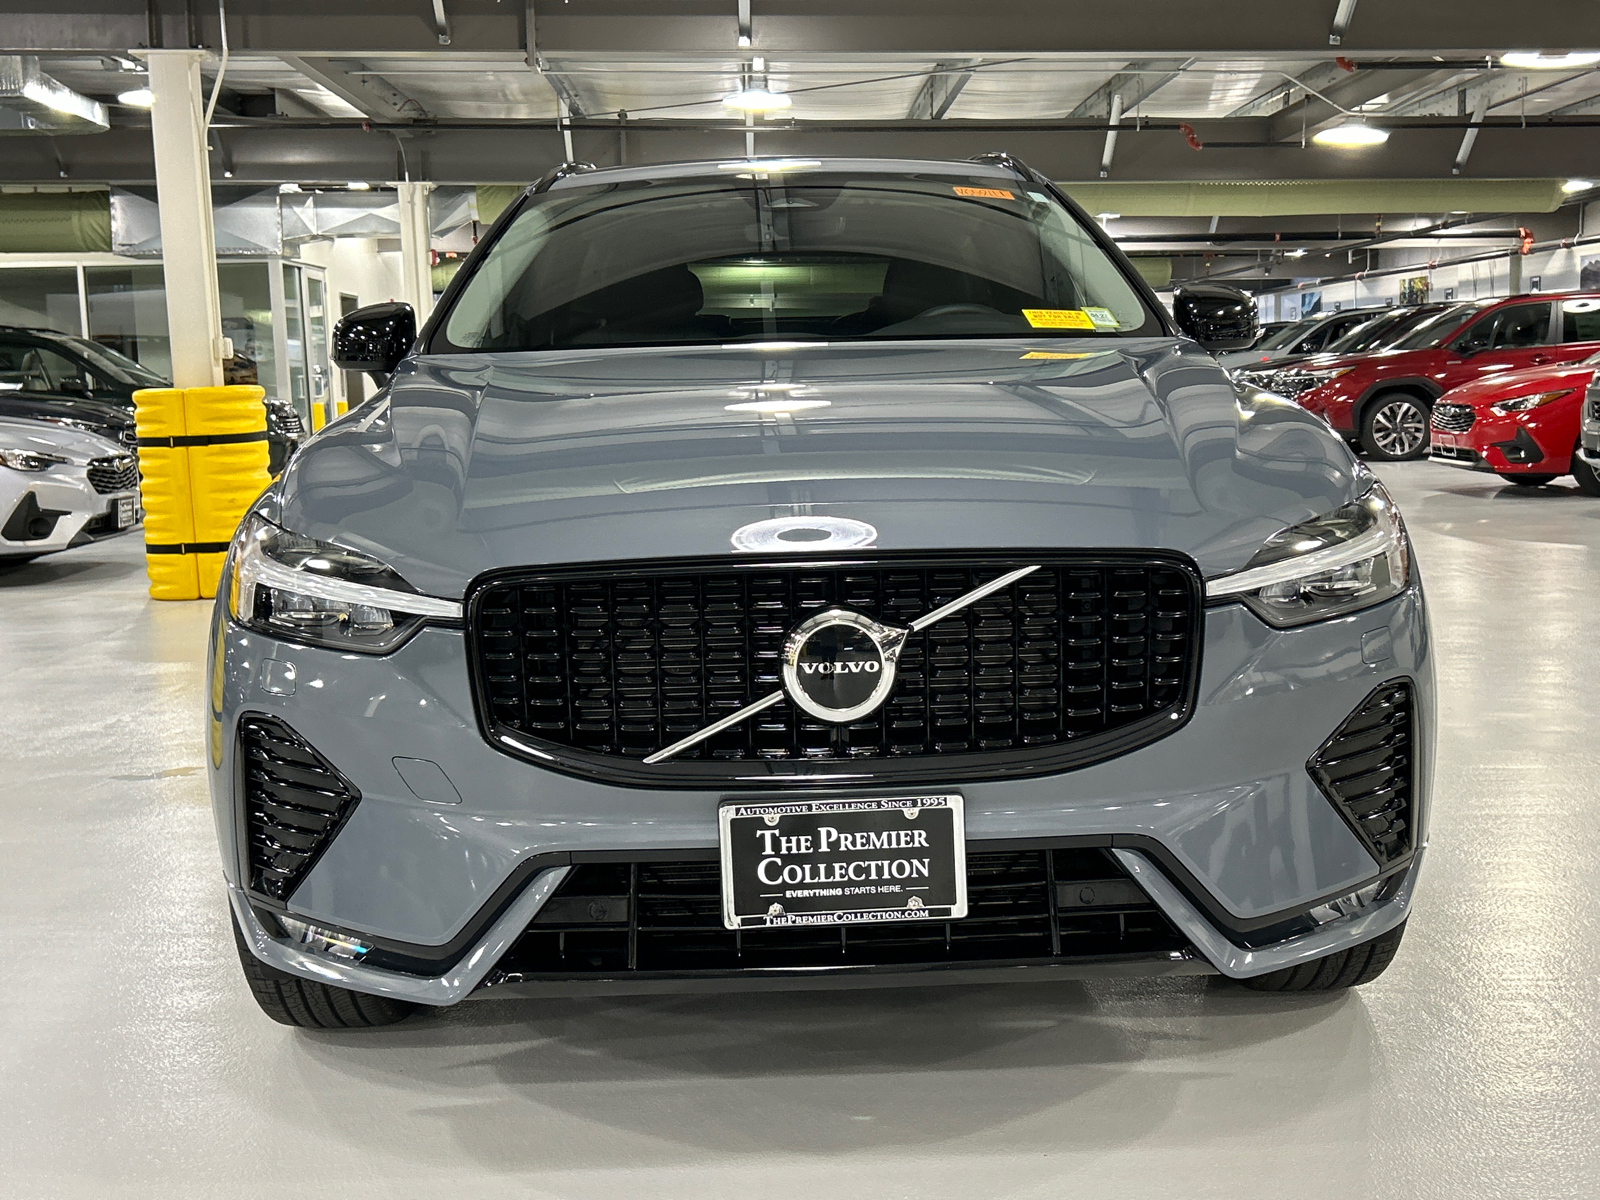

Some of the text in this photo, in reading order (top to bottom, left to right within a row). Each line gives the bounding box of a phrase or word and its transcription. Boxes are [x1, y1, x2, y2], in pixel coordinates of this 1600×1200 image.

[799, 661, 880, 674] VOLVO
[916, 797, 946, 807] 1995
[756, 826, 930, 855] THE PREMIER
[757, 857, 930, 886] COLLECTION
[785, 884, 904, 898] EVERYTHING STARTS HERE.
